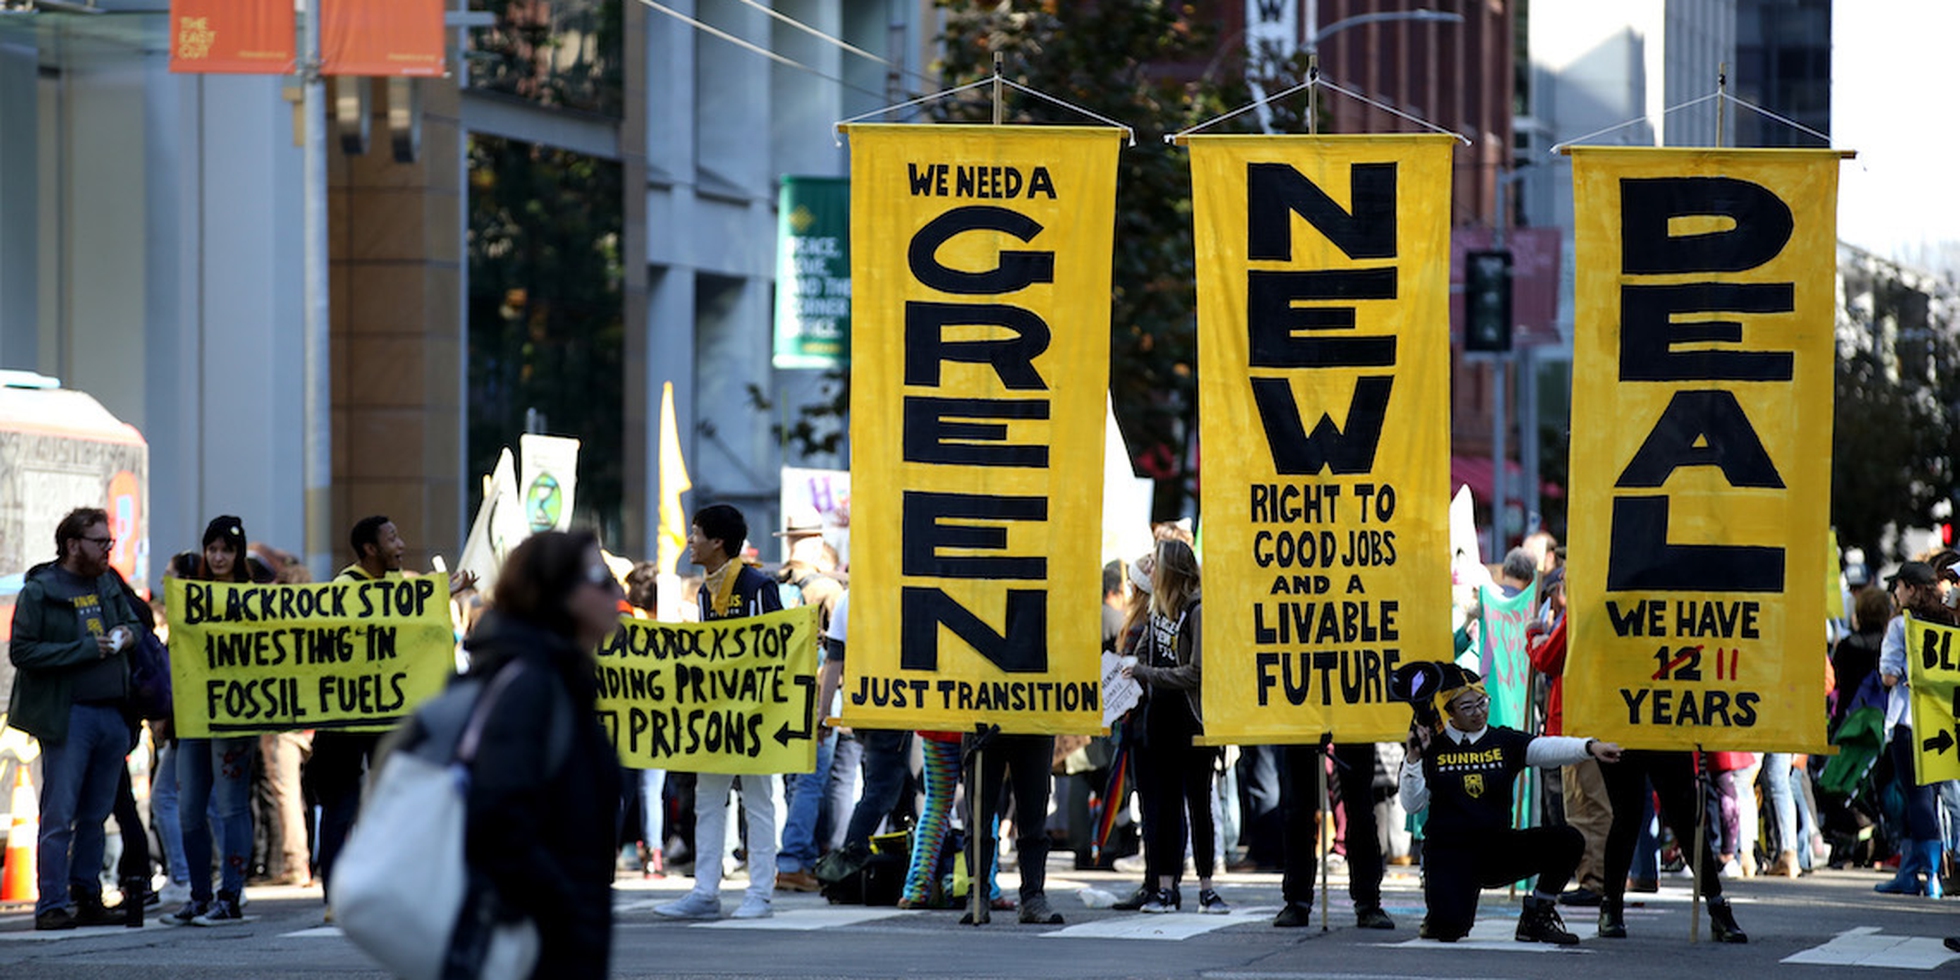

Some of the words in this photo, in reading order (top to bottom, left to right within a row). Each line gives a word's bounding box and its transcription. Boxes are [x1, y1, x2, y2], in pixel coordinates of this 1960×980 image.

[181, 17, 207, 30] THE
[907, 162, 949, 197] WE
[955, 165, 1023, 199] NEED
[1027, 166, 1057, 200] A
[1247, 162, 1398, 476] NEW
[1606, 177, 1795, 593] DEAL
[901, 206, 1054, 673] GREEN
[1250, 484, 1341, 524] RIGHT
[1354, 483, 1396, 524] TO
[1253, 530, 1337, 568] GOOD
[1341, 530, 1397, 567] JOBS
[184, 582, 349, 625] BLACKROCK
[358, 579, 435, 618] STOP
[1270, 575, 1331, 595] AND
[1346, 574, 1366, 594] A
[1253, 600, 1399, 645] LIVABLE
[1605, 599, 1667, 638] WE
[1676, 600, 1760, 640] HAVE
[205, 626, 353, 670] INVESTING
[366, 624, 397, 661] IN
[596, 621, 727, 662] LACKROCK
[728, 622, 795, 661] STOP
[207, 677, 306, 719] FOSSIL
[319, 672, 408, 714] FUELS
[595, 665, 665, 700] NDING
[675, 662, 789, 704] PRIVATE
[851, 676, 930, 709] JUST
[936, 680, 1099, 712] TRANSITION
[1256, 648, 1402, 707] FUTURE
[1619, 688, 1762, 728] YEARS
[629, 706, 764, 759] PRISONS
[1437, 748, 1504, 766] SUNRISE
